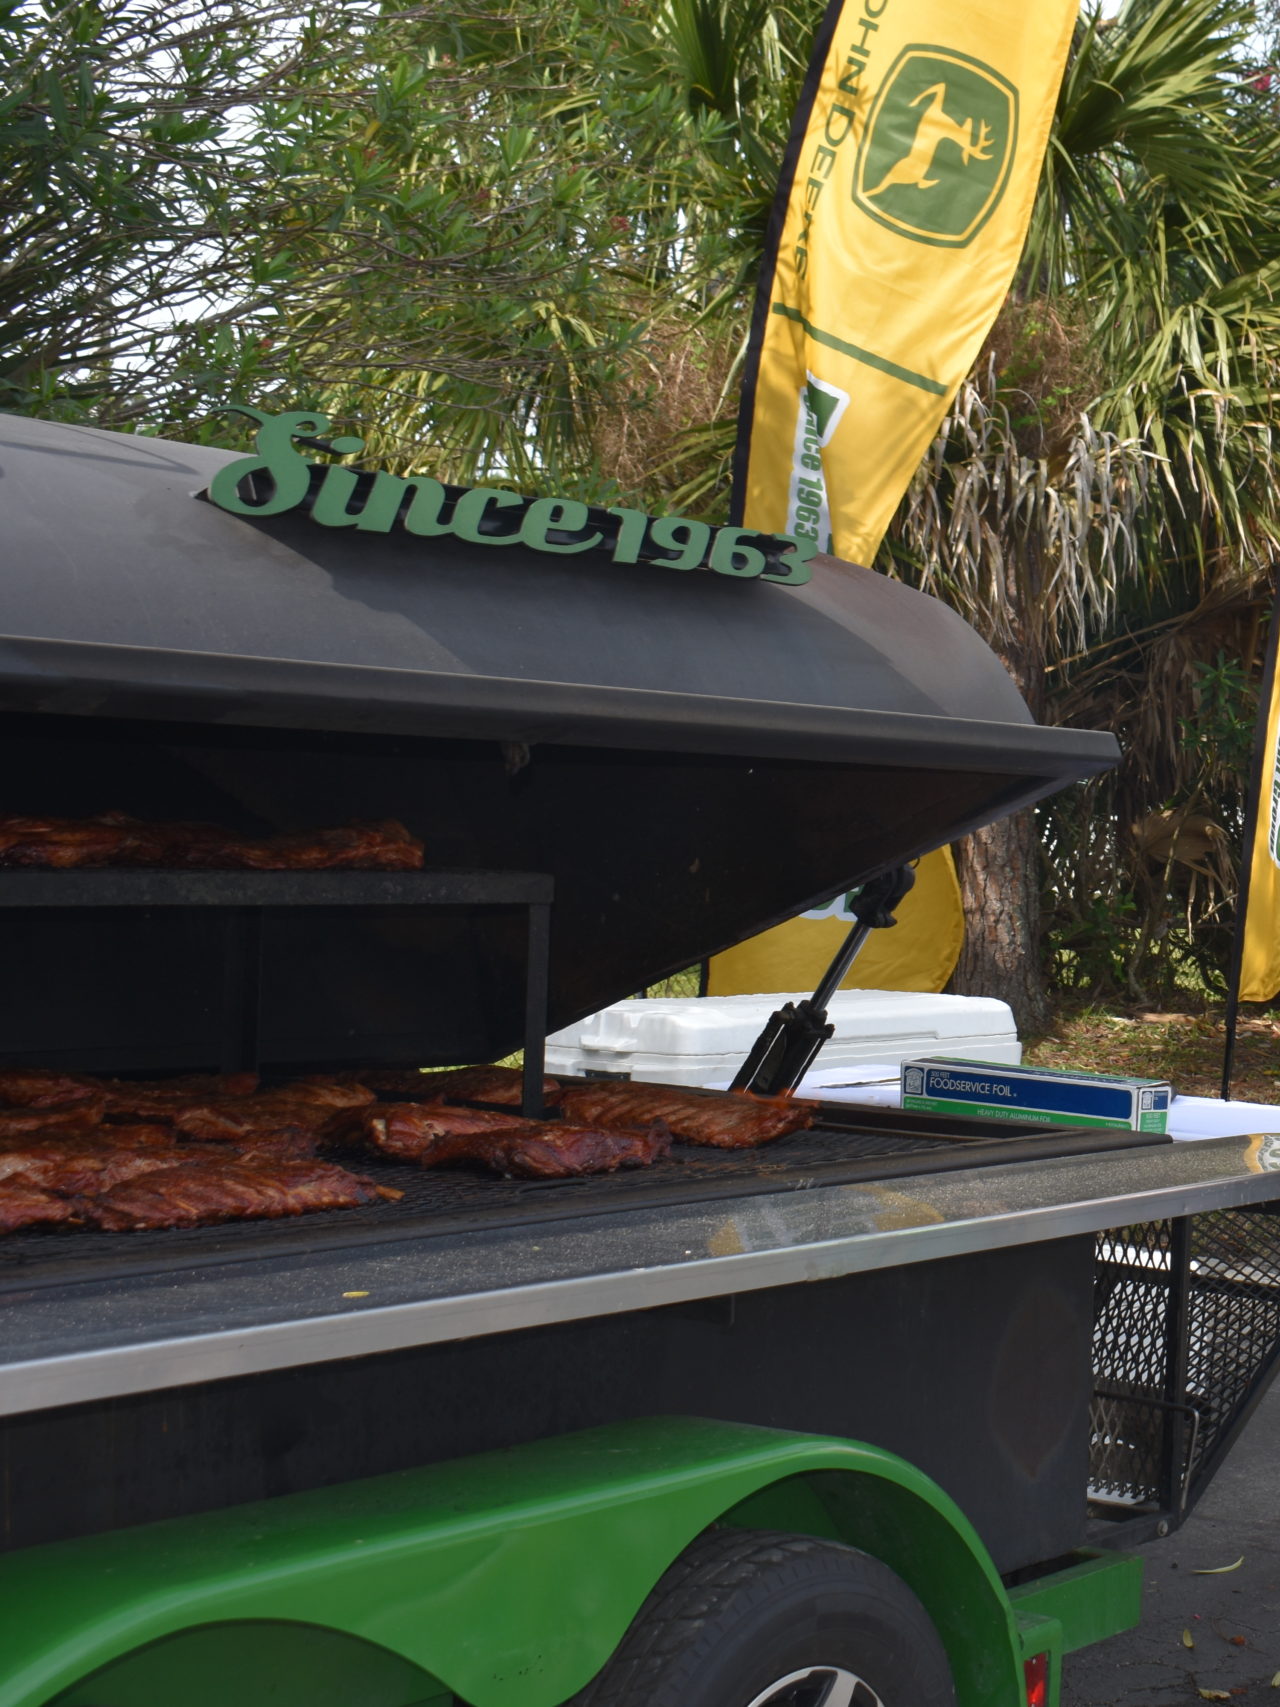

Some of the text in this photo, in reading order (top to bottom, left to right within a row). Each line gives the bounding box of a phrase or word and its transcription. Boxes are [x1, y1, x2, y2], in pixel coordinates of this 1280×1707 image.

[209, 403, 819, 586] Since 1963
[794, 476, 823, 542] 1963
[929, 1077, 990, 1094] FOODSERVICE
[992, 1084, 1012, 1097] FOIL
[977, 1108, 994, 1117] HEAVY
[995, 1110, 1009, 1119] DUTY
